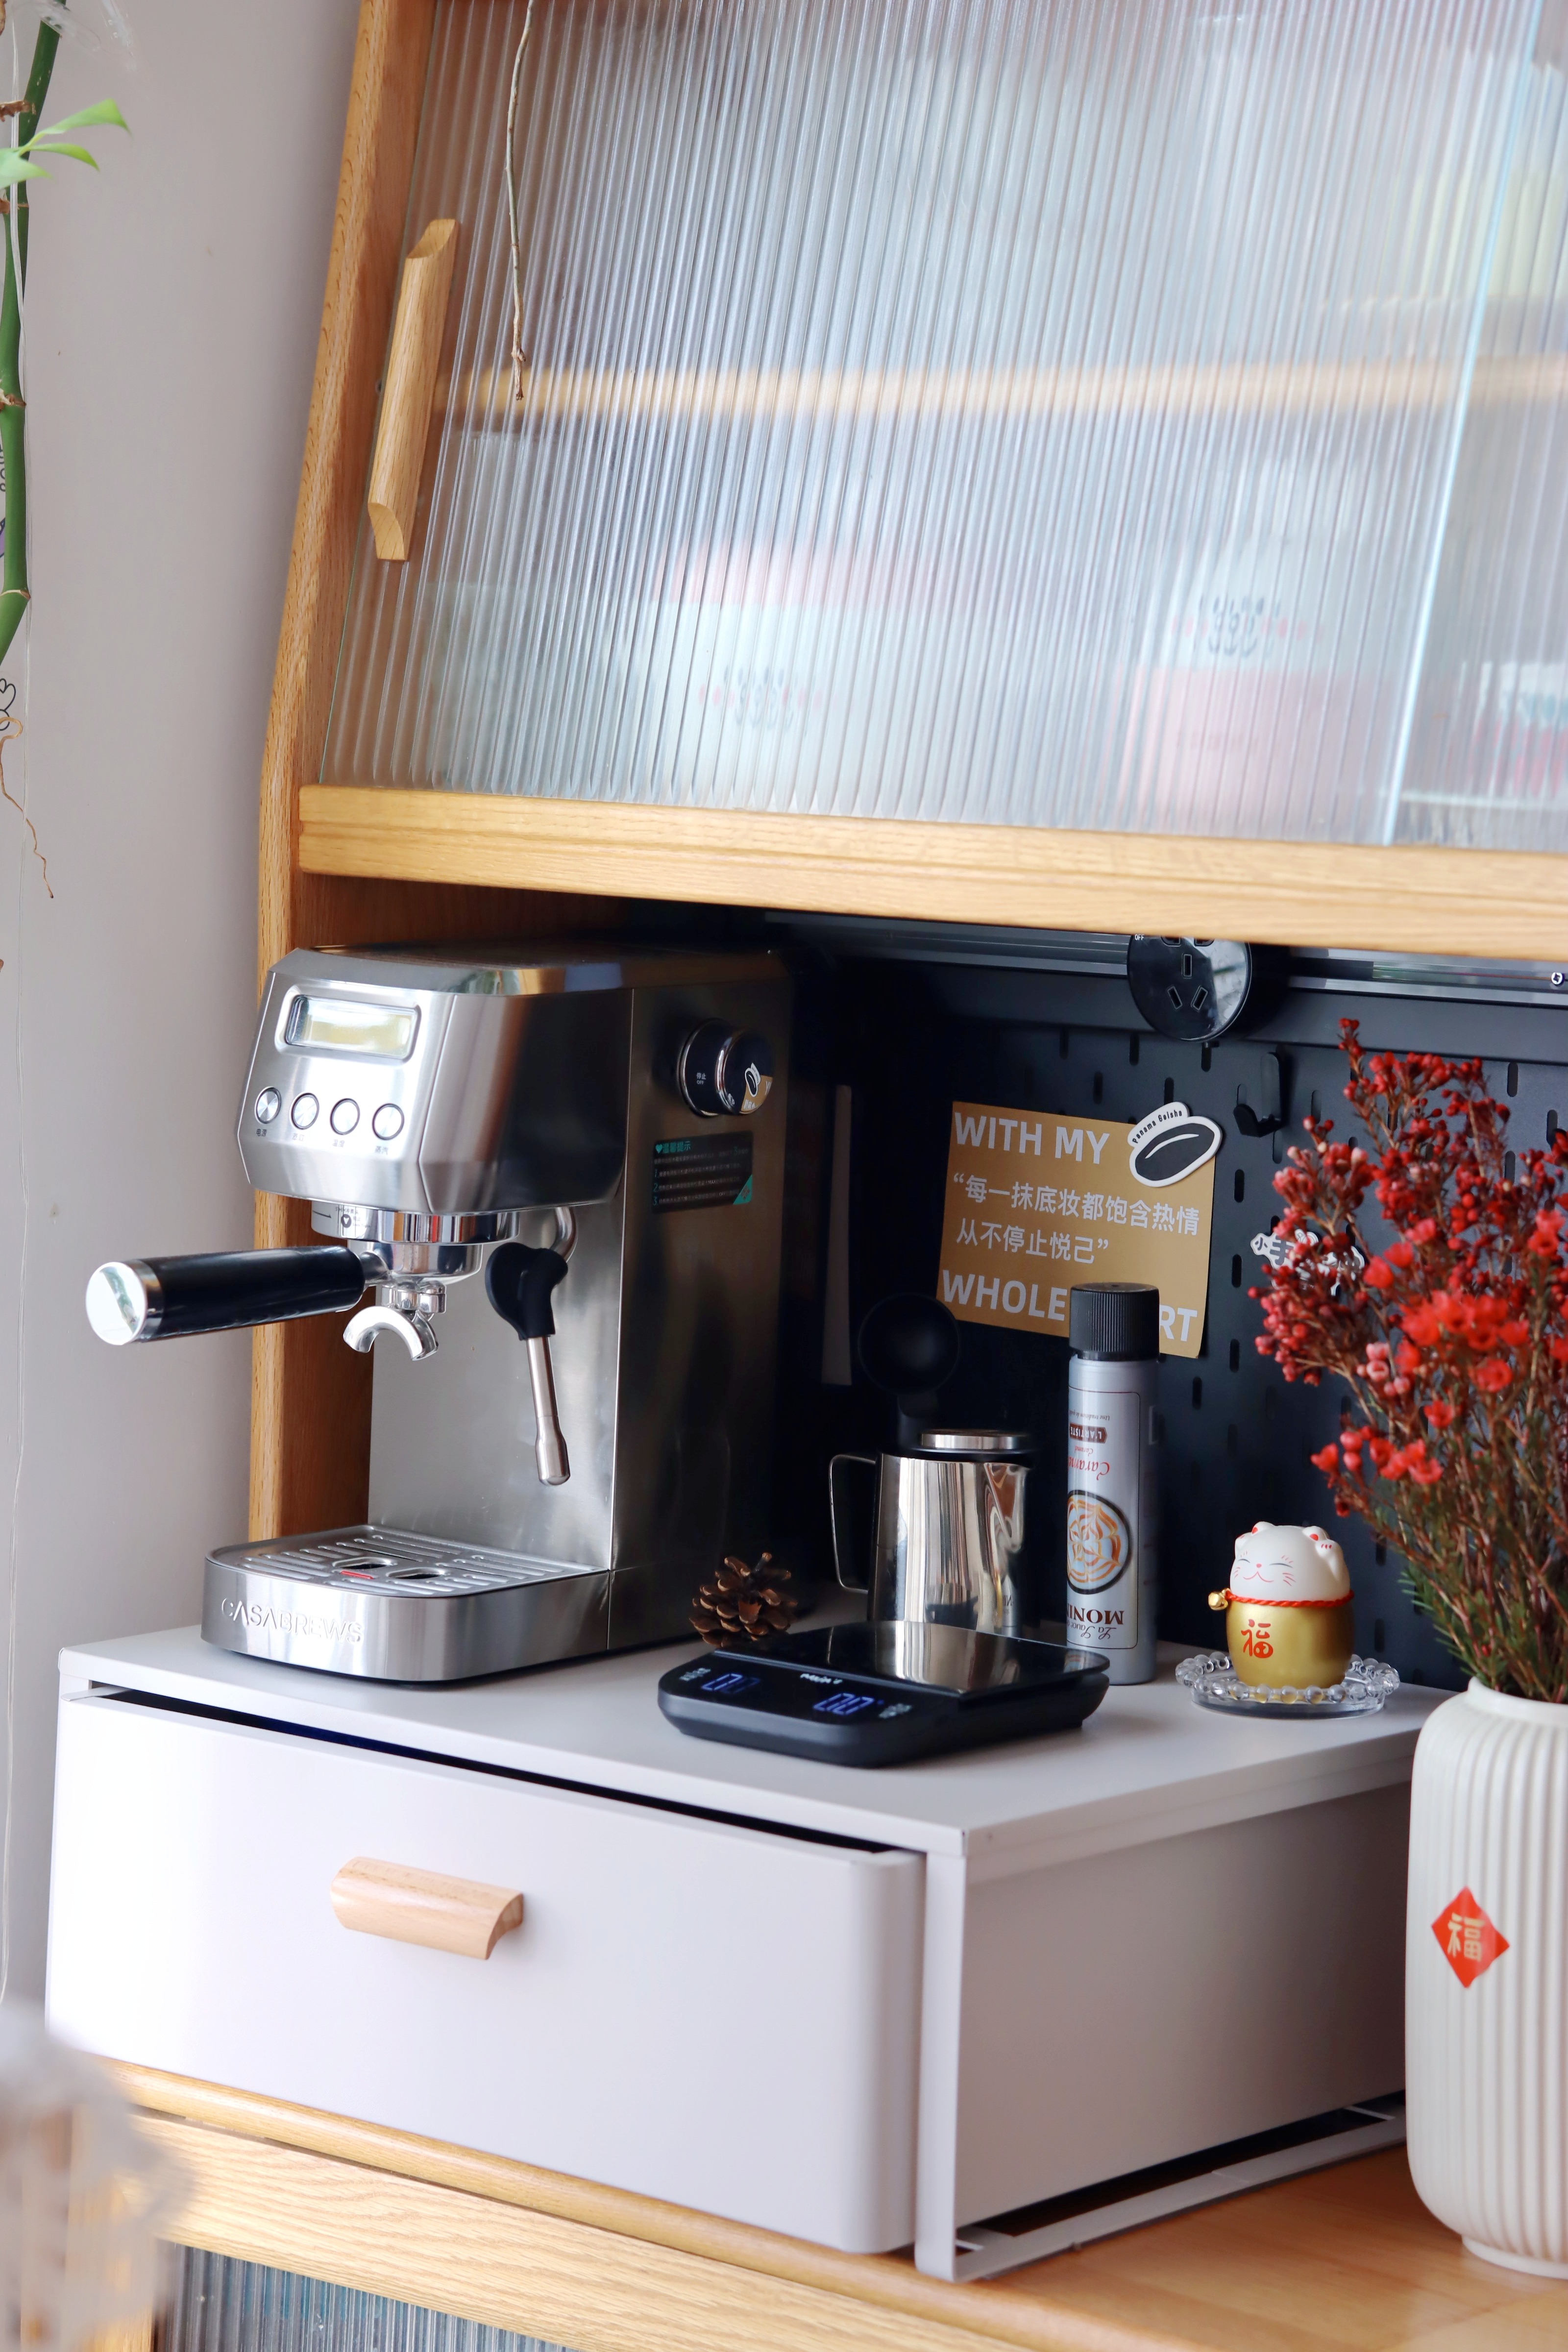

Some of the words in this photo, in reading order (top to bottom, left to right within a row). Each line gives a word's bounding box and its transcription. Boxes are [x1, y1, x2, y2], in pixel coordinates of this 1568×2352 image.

[255, 1128, 267, 1137] 电源
[954, 1111, 1042, 1156] WITH
[1054, 1125, 1110, 1165] MY
[1132, 1120, 1156, 1144] Panama
[1158, 1109, 1182, 1122] Geisha
[942, 1269, 1068, 1322] WHOLE
[1070, 1426, 1102, 1440] L'ARTISTE
[221, 1597, 363, 1642] CASABREWS
[1240, 1618, 1274, 1659] 福
[1447, 1911, 1485, 1962] 福
